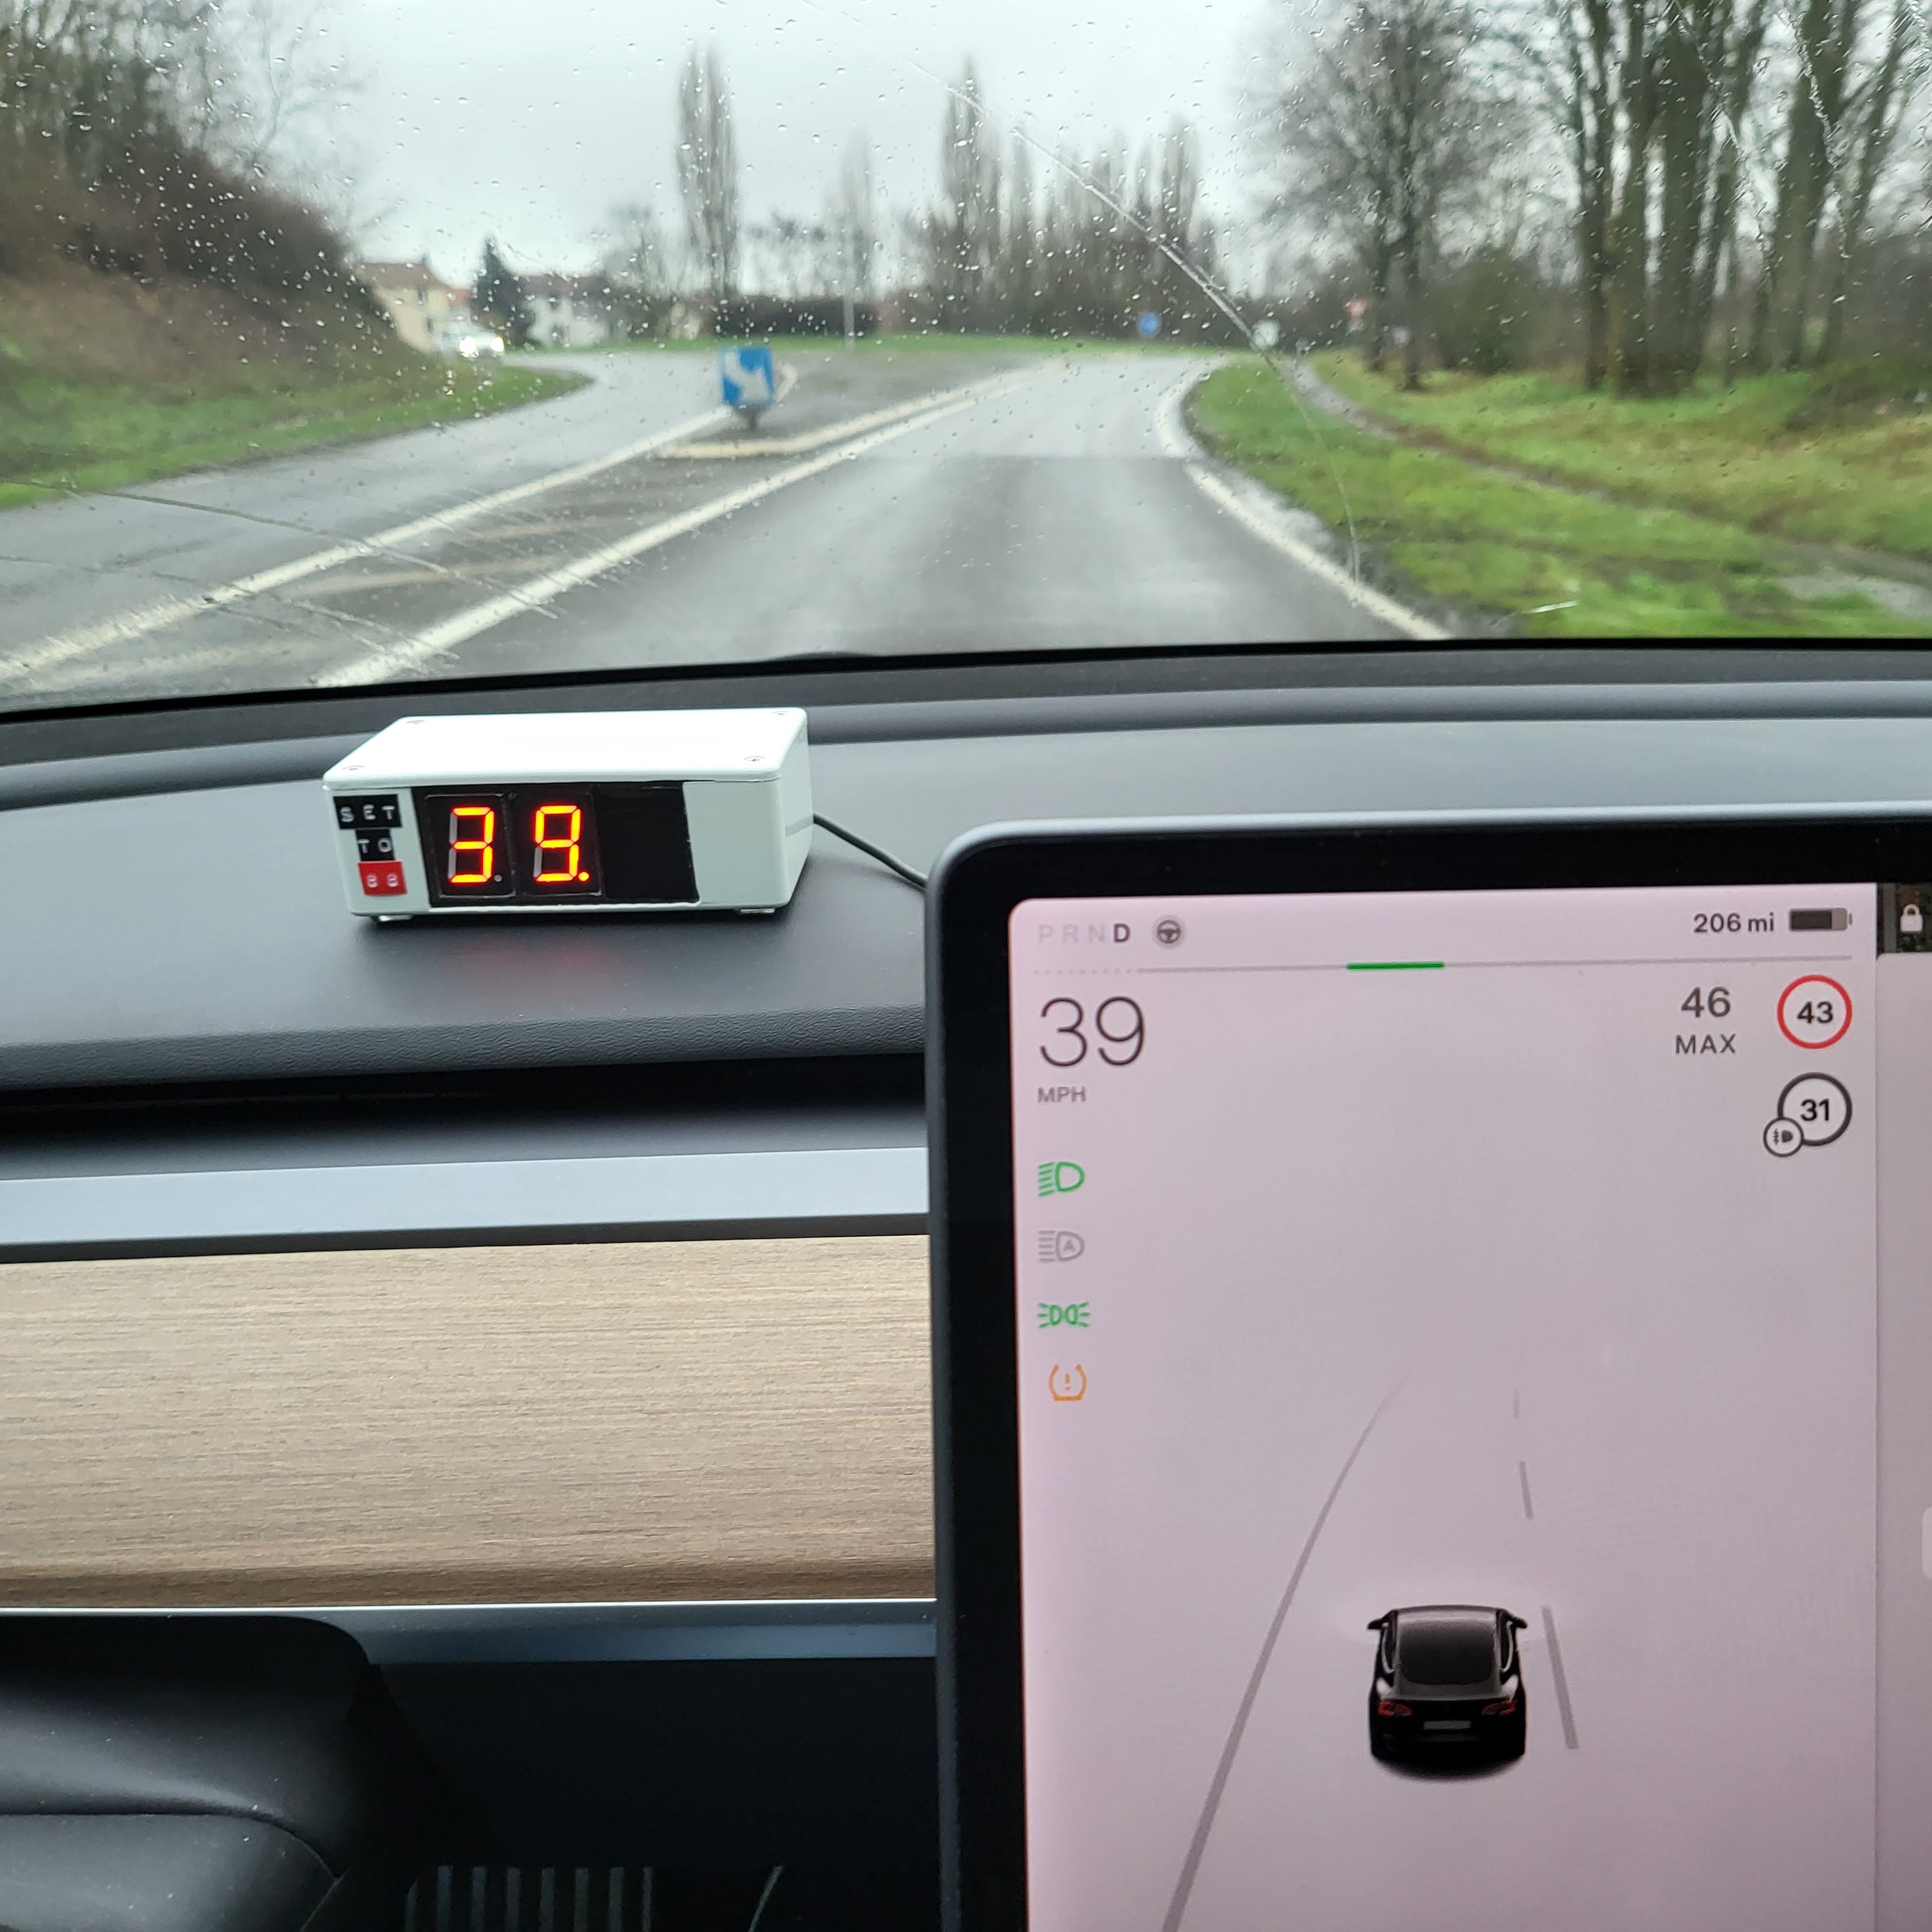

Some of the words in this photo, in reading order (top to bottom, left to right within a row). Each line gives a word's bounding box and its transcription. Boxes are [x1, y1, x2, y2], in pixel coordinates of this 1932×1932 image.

[340, 805, 395, 822] SET
[358, 838, 391, 853] TO
[1693, 913, 1742, 933] 206
[1747, 912, 1774, 932] mi
[1681, 987, 1731, 1018] 46
[1797, 1001, 1833, 1024] 43
[1040, 996, 1144, 1067] 39
[1675, 1034, 1736, 1054] MAX
[1038, 1086, 1086, 1103] MPH
[1800, 1098, 1830, 1122] 31
